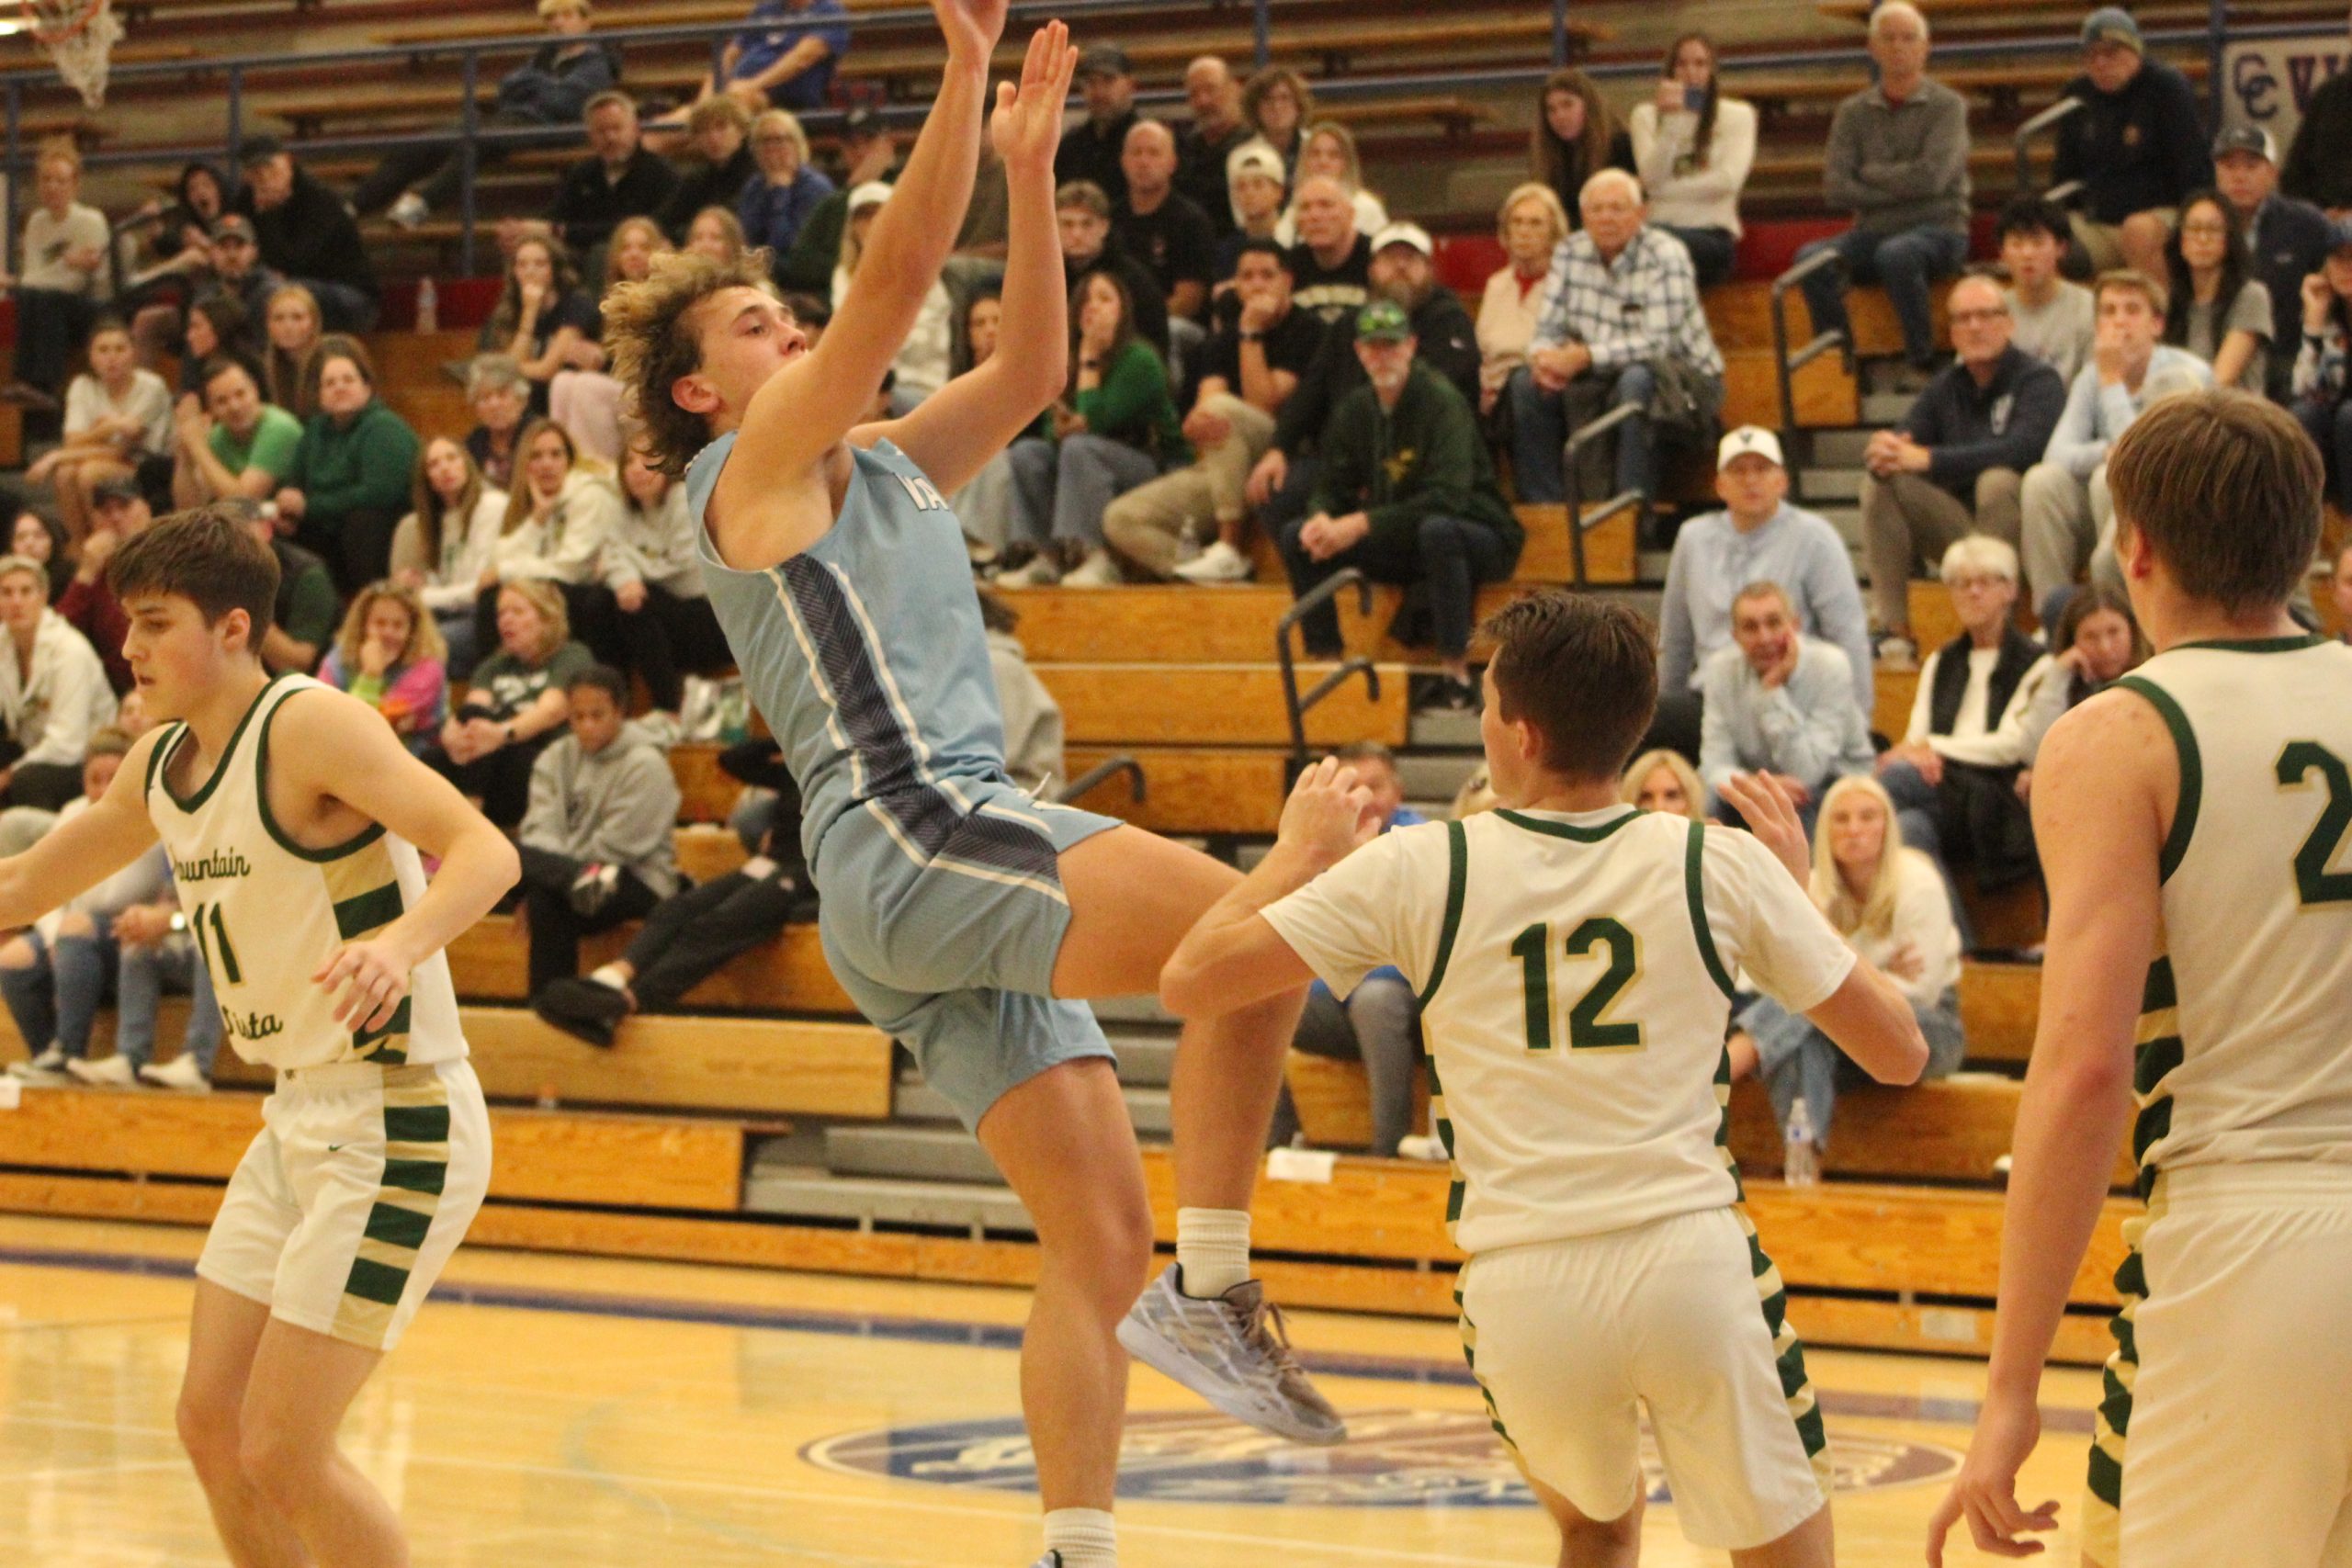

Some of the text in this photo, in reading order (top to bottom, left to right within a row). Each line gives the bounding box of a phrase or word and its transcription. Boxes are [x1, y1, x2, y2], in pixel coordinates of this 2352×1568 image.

[169, 843, 251, 883] ountain
[193, 902, 243, 986] 11
[1509, 916, 1644, 1053] 12
